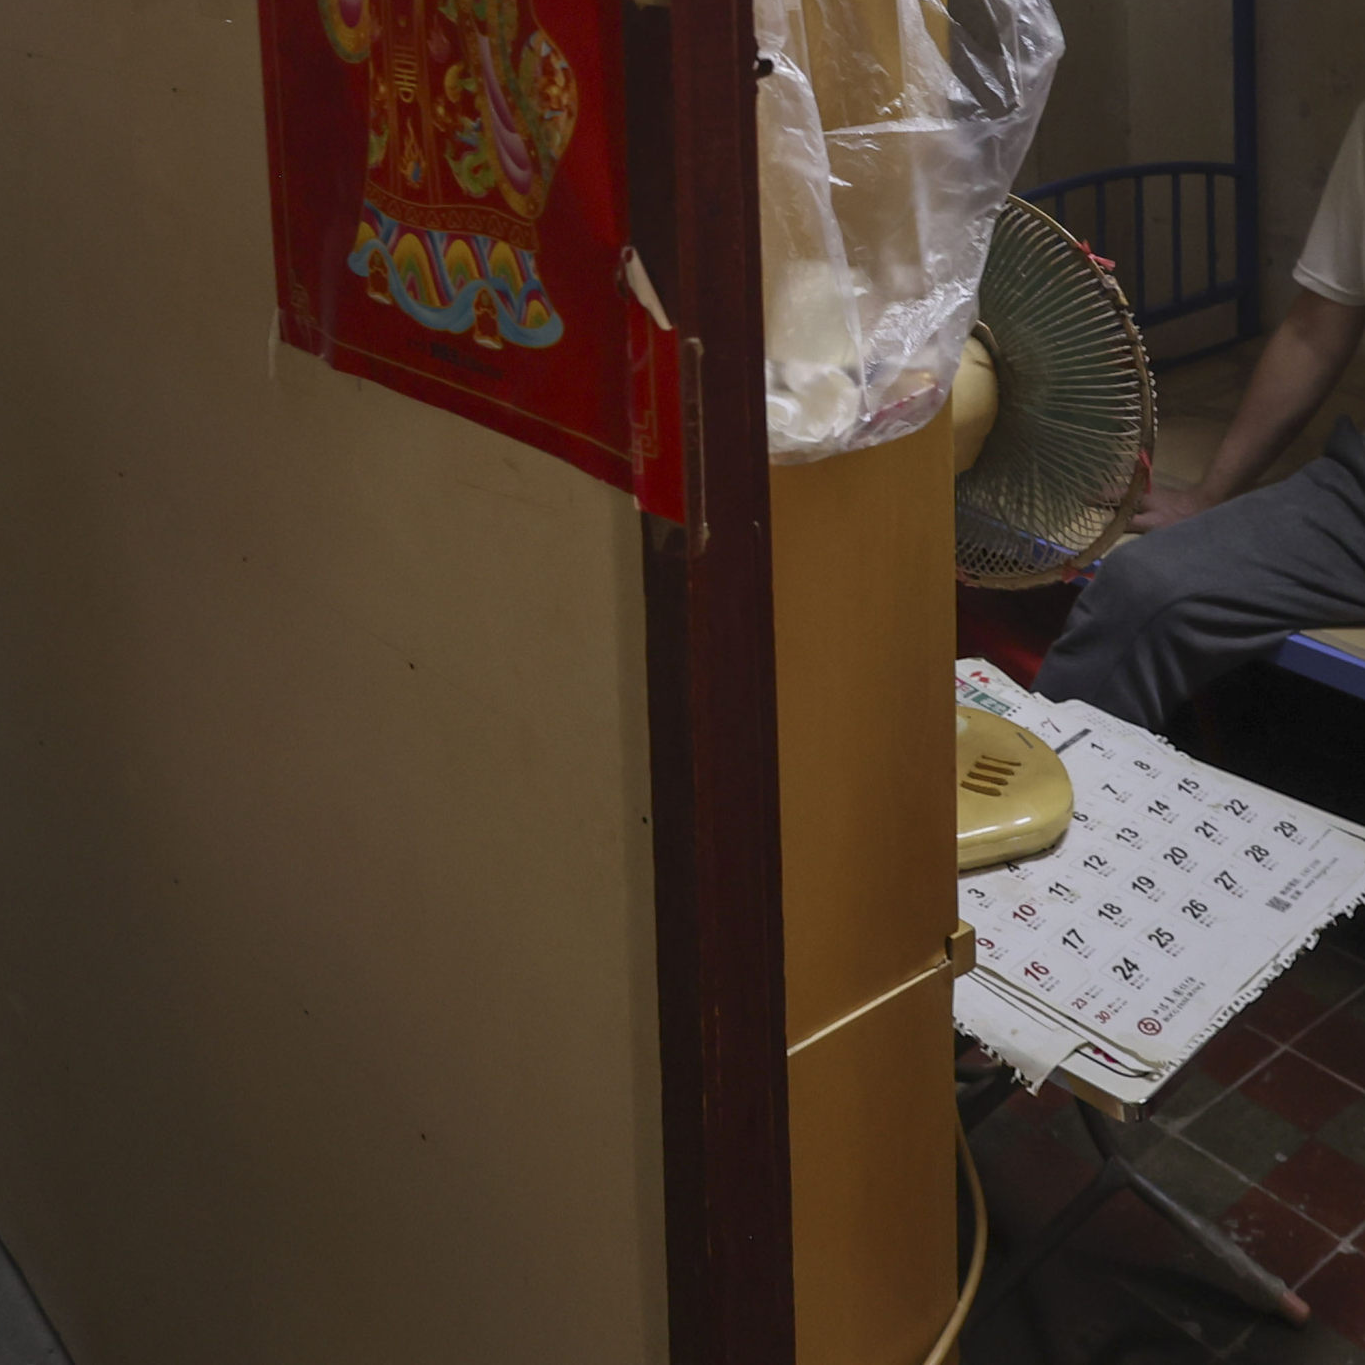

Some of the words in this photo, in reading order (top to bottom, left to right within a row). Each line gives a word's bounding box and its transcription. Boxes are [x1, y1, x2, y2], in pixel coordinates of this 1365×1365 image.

[968, 889, 985, 898] 3
[1004, 861, 1020, 872] 4
[1072, 811, 1089, 823] 6
[1102, 784, 1117, 794] 7
[1134, 761, 1150, 770] 8
[977, 937, 995, 950] 9
[1013, 905, 1036, 921] 10
[1049, 883, 1070, 896] 11
[1084, 855, 1107, 870] 12
[1117, 828, 1138, 842] 13
[1148, 801, 1169, 815] 14
[1178, 779, 1199, 794] 15
[1025, 962, 1049, 981] 16
[1063, 929, 1084, 949] 17
[1099, 904, 1121, 920] 18
[1132, 877, 1154, 893] 19
[1164, 847, 1187, 865] 20
[1195, 821, 1217, 838] 21
[1224, 800, 1248, 816] 22
[1072, 998, 1087, 1009] 23
[1113, 958, 1139, 980] 24
[1148, 928, 1174, 948] 25
[1182, 900, 1207, 919] 26
[1214, 871, 1236, 890] 27
[1245, 845, 1269, 863] 28
[1274, 822, 1297, 838] 29
[1095, 1011, 1110, 1024] 30
